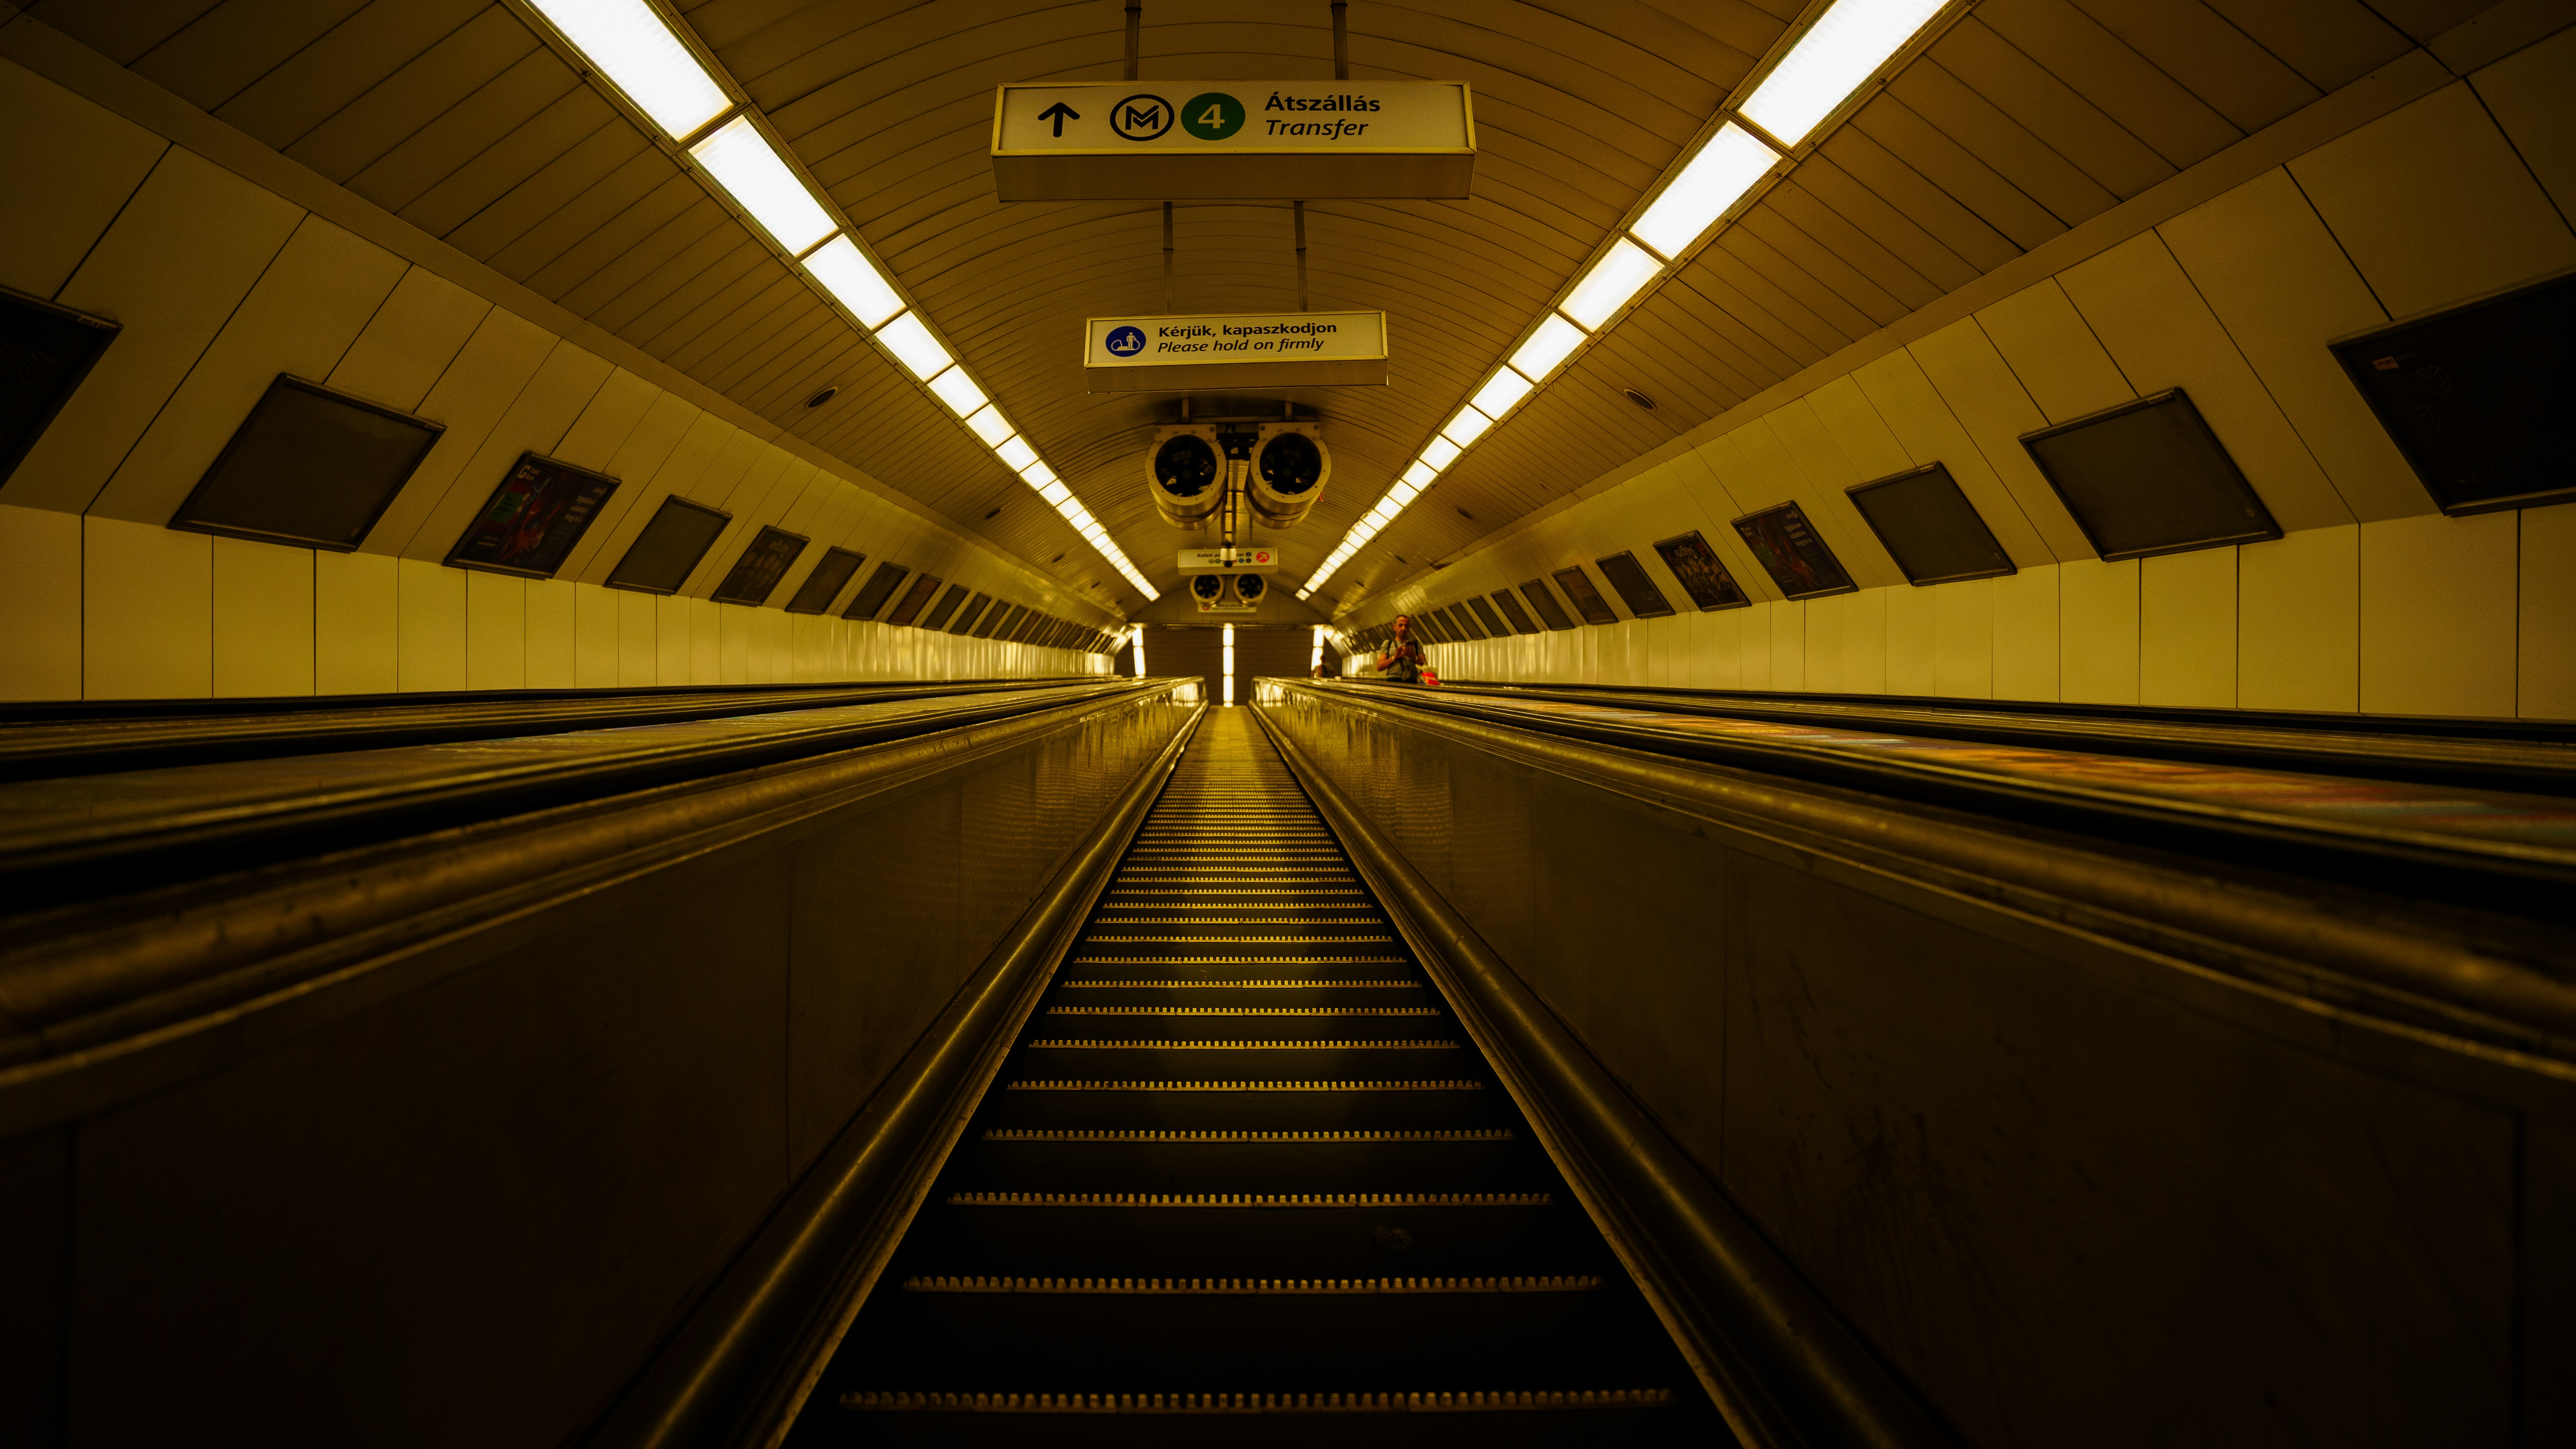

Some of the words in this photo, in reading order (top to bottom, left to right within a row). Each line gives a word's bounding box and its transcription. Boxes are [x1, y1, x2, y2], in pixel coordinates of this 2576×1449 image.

[1198, 104, 1225, 129] 4
[1264, 91, 1381, 112] Átszállás
[1266, 118, 1369, 140] Transfer
[1159, 325, 1216, 340] Kérjük,
[1223, 322, 1337, 338] kapaszkodjon
[1157, 341, 1209, 353] Please
[1213, 340, 1250, 351] hold
[1254, 342, 1274, 350] on
[1277, 337, 1325, 352] firmly
